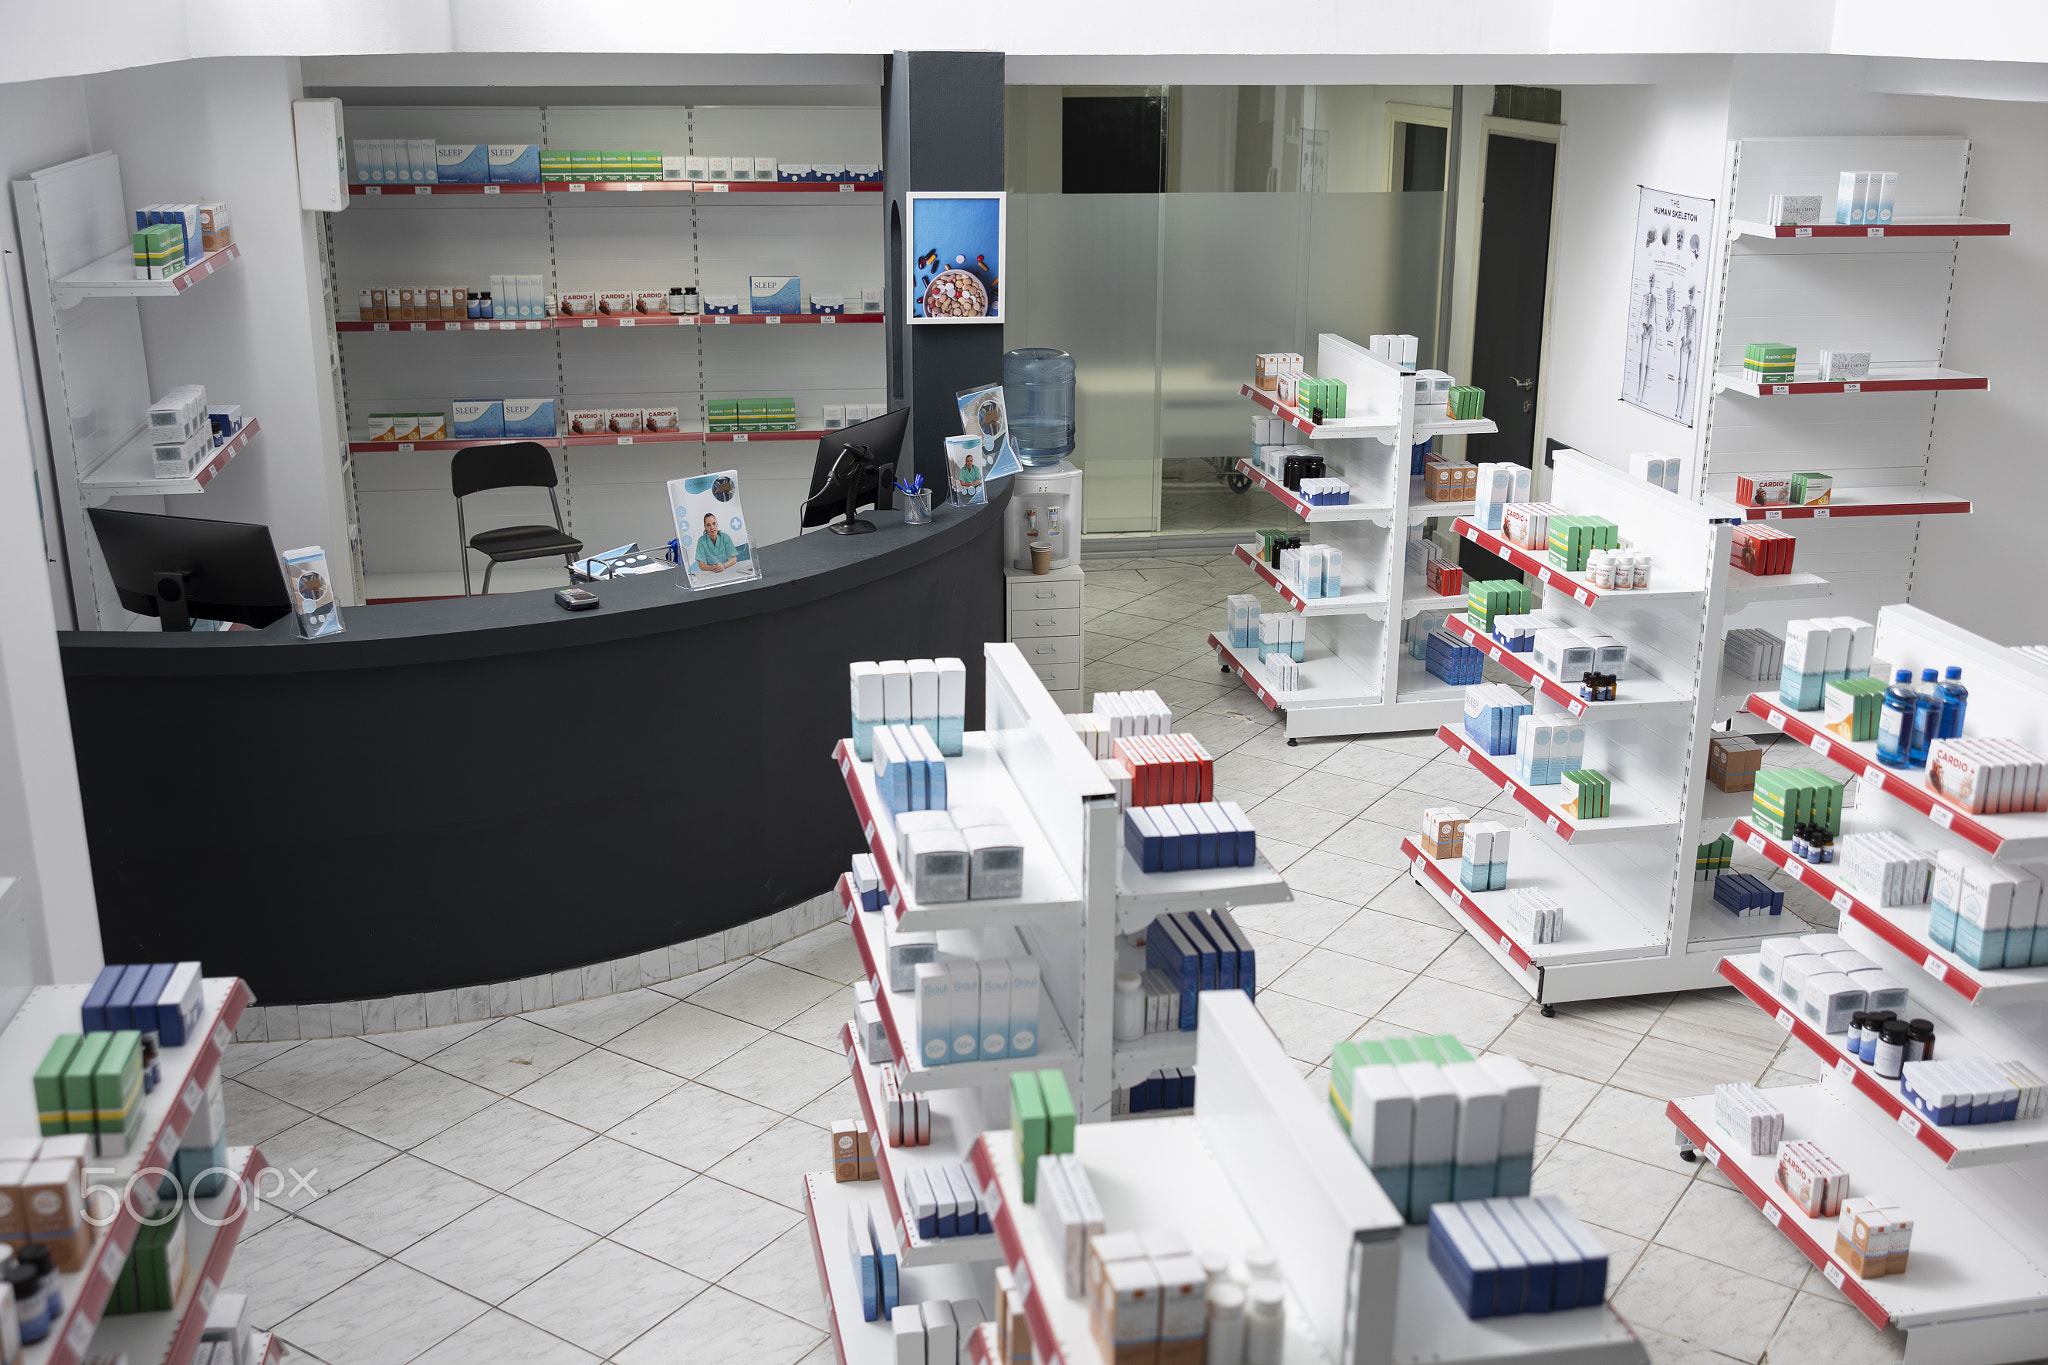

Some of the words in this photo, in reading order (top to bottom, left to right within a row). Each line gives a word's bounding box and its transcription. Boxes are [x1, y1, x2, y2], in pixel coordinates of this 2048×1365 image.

[438, 149, 463, 157] SLEEP
[490, 149, 515, 157] SLEEP
[1670, 199, 1681, 209] THE
[1653, 206, 1671, 217] HUMAN
[1672, 210, 1698, 222] SKELETON
[455, 406, 479, 415] SLEEP
[506, 405, 530, 414] SLEEP
[574, 412, 598, 420] CARDIO
[1506, 508, 1525, 522] CARDIO
[1465, 692, 1479, 710] SLEEP
[1936, 749, 1968, 773] CARDIO
[840, 1139, 852, 1147] 50+
[1783, 1152, 1807, 1181] CARDIO
